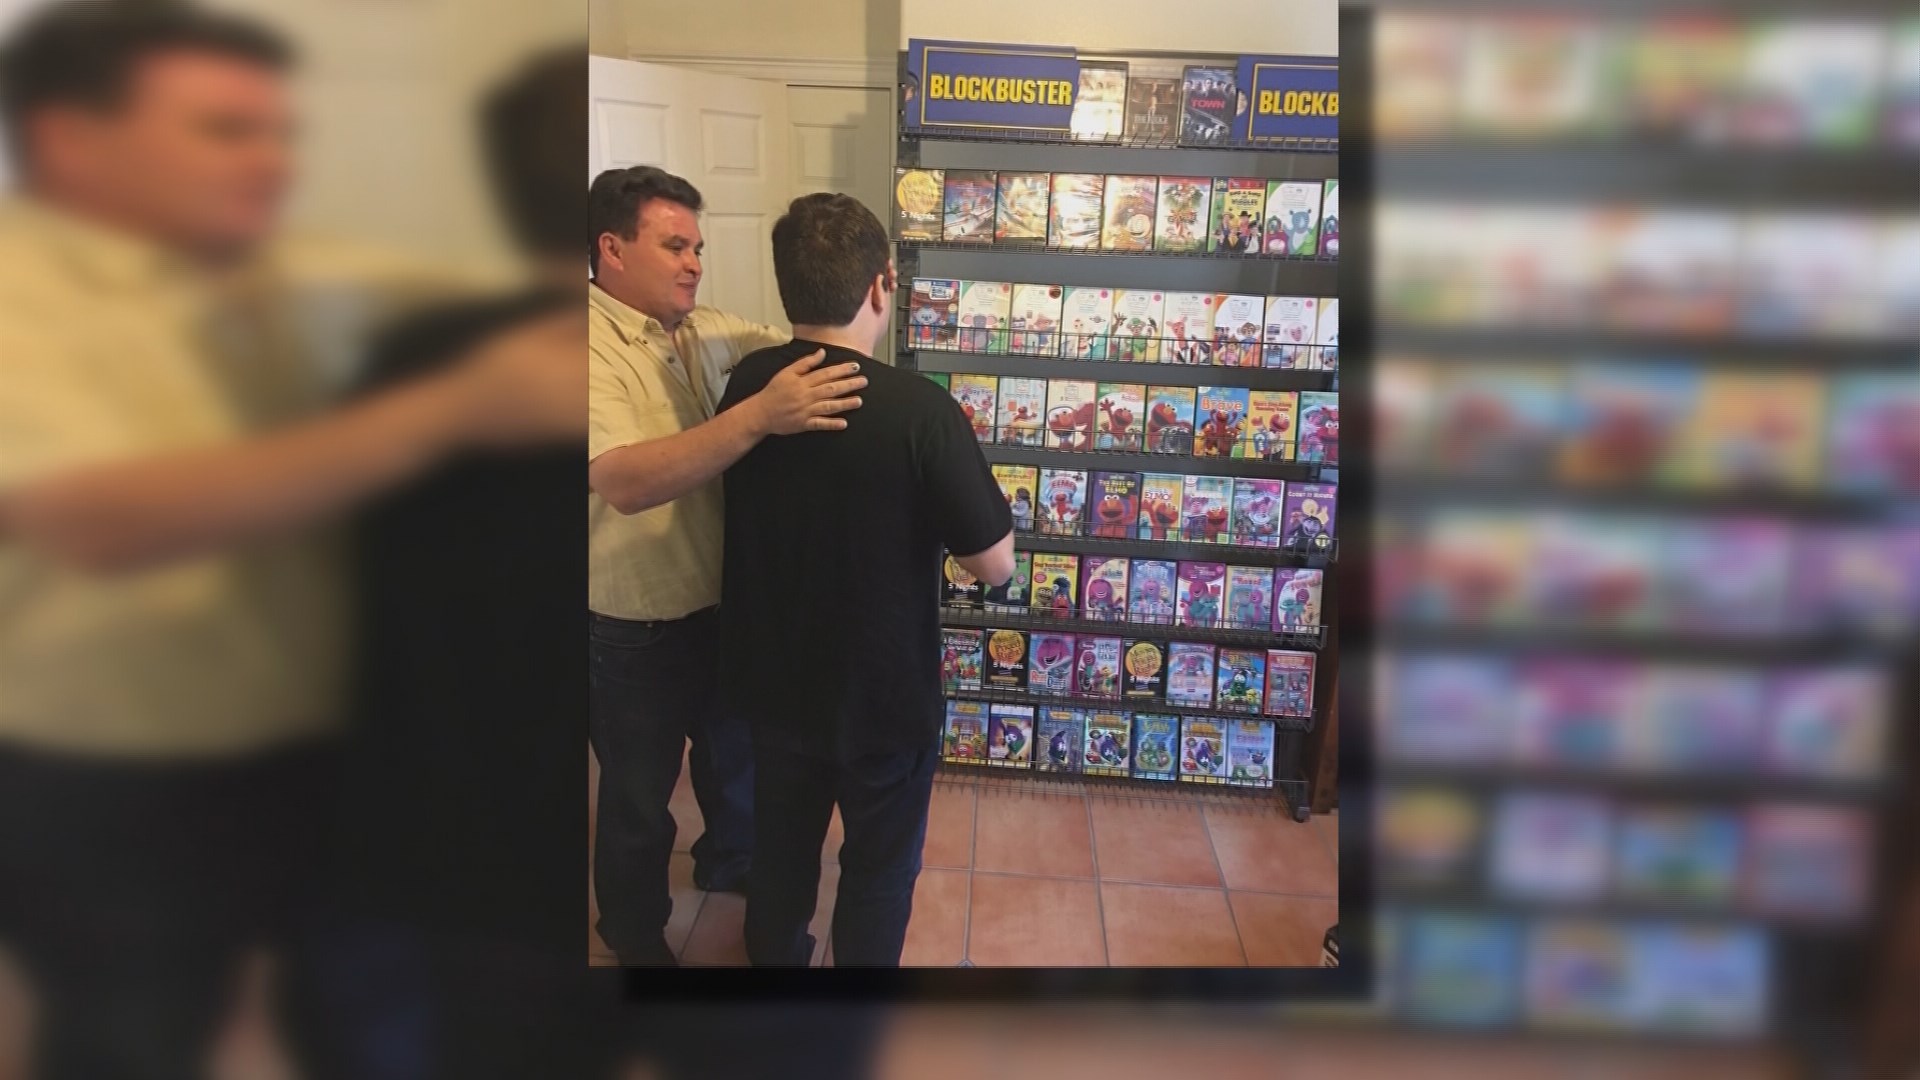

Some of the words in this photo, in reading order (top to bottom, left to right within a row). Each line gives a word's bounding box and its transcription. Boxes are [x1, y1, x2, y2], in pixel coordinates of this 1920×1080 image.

[929, 73, 1073, 106] BLOCKBUSTER
[1190, 97, 1225, 109] TOWN
[901, 210, 909, 219] 5
[1202, 395, 1244, 413] Brave
[999, 661, 1024, 670] Nights
